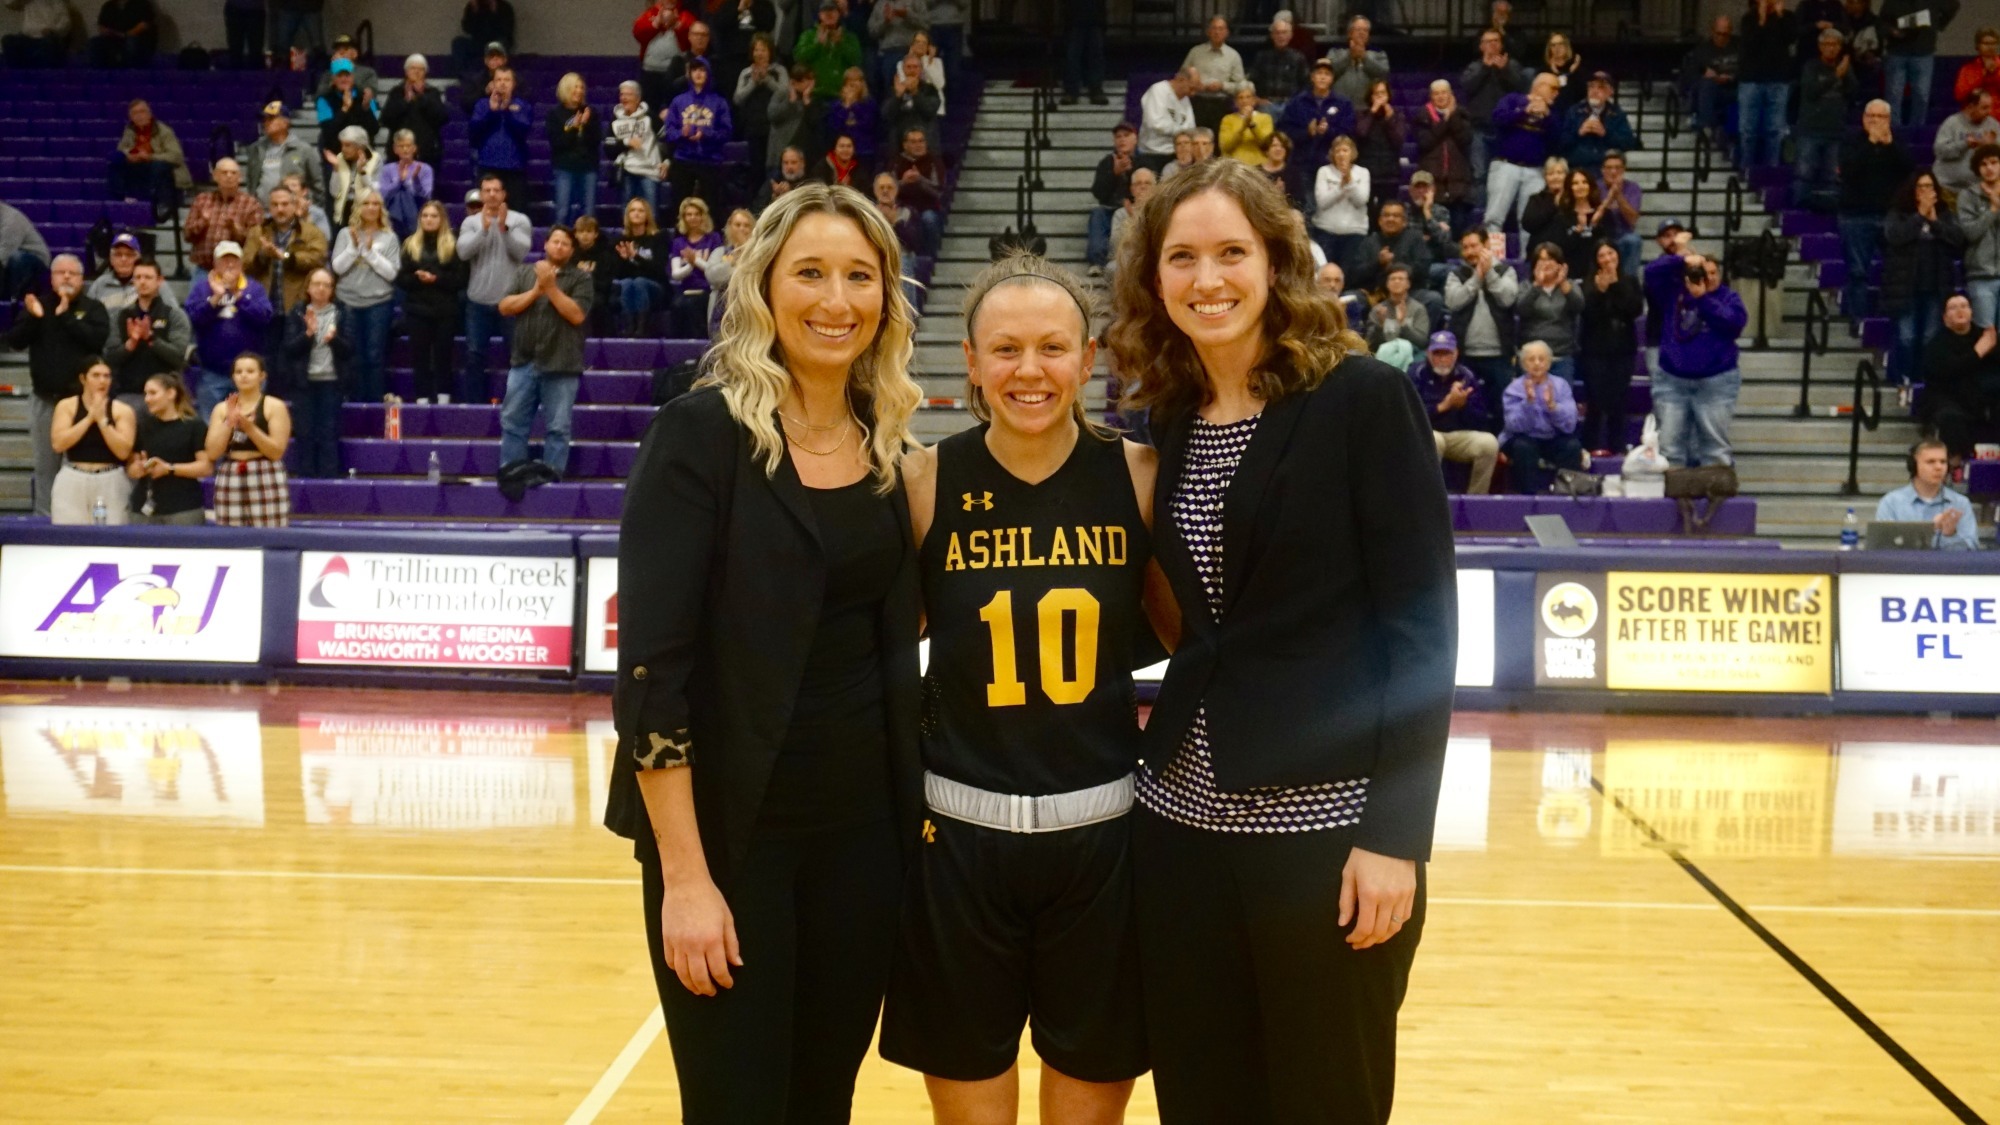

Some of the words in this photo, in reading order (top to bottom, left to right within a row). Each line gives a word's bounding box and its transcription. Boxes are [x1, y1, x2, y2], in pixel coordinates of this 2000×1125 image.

[945, 526, 1127, 571] ASHLAND
[364, 557, 478, 583] Trillium
[489, 561, 568, 588] Creek
[376, 588, 555, 620] Dermatology
[1618, 585, 1712, 613] SCORE
[1722, 587, 1821, 615] WINGS
[1881, 596, 1997, 624] BARE
[334, 622, 442, 641] BRUNSWICK
[460, 626, 534, 644] MEDINA
[1618, 618, 1687, 641] AFTER
[1697, 619, 1739, 642] THE
[1748, 620, 1821, 645] GAME!
[1916, 633, 1963, 659] FL
[318, 640, 439, 660] WADSWORTH
[457, 645, 549, 662] WOOSTER
[979, 588, 1100, 707] 10
